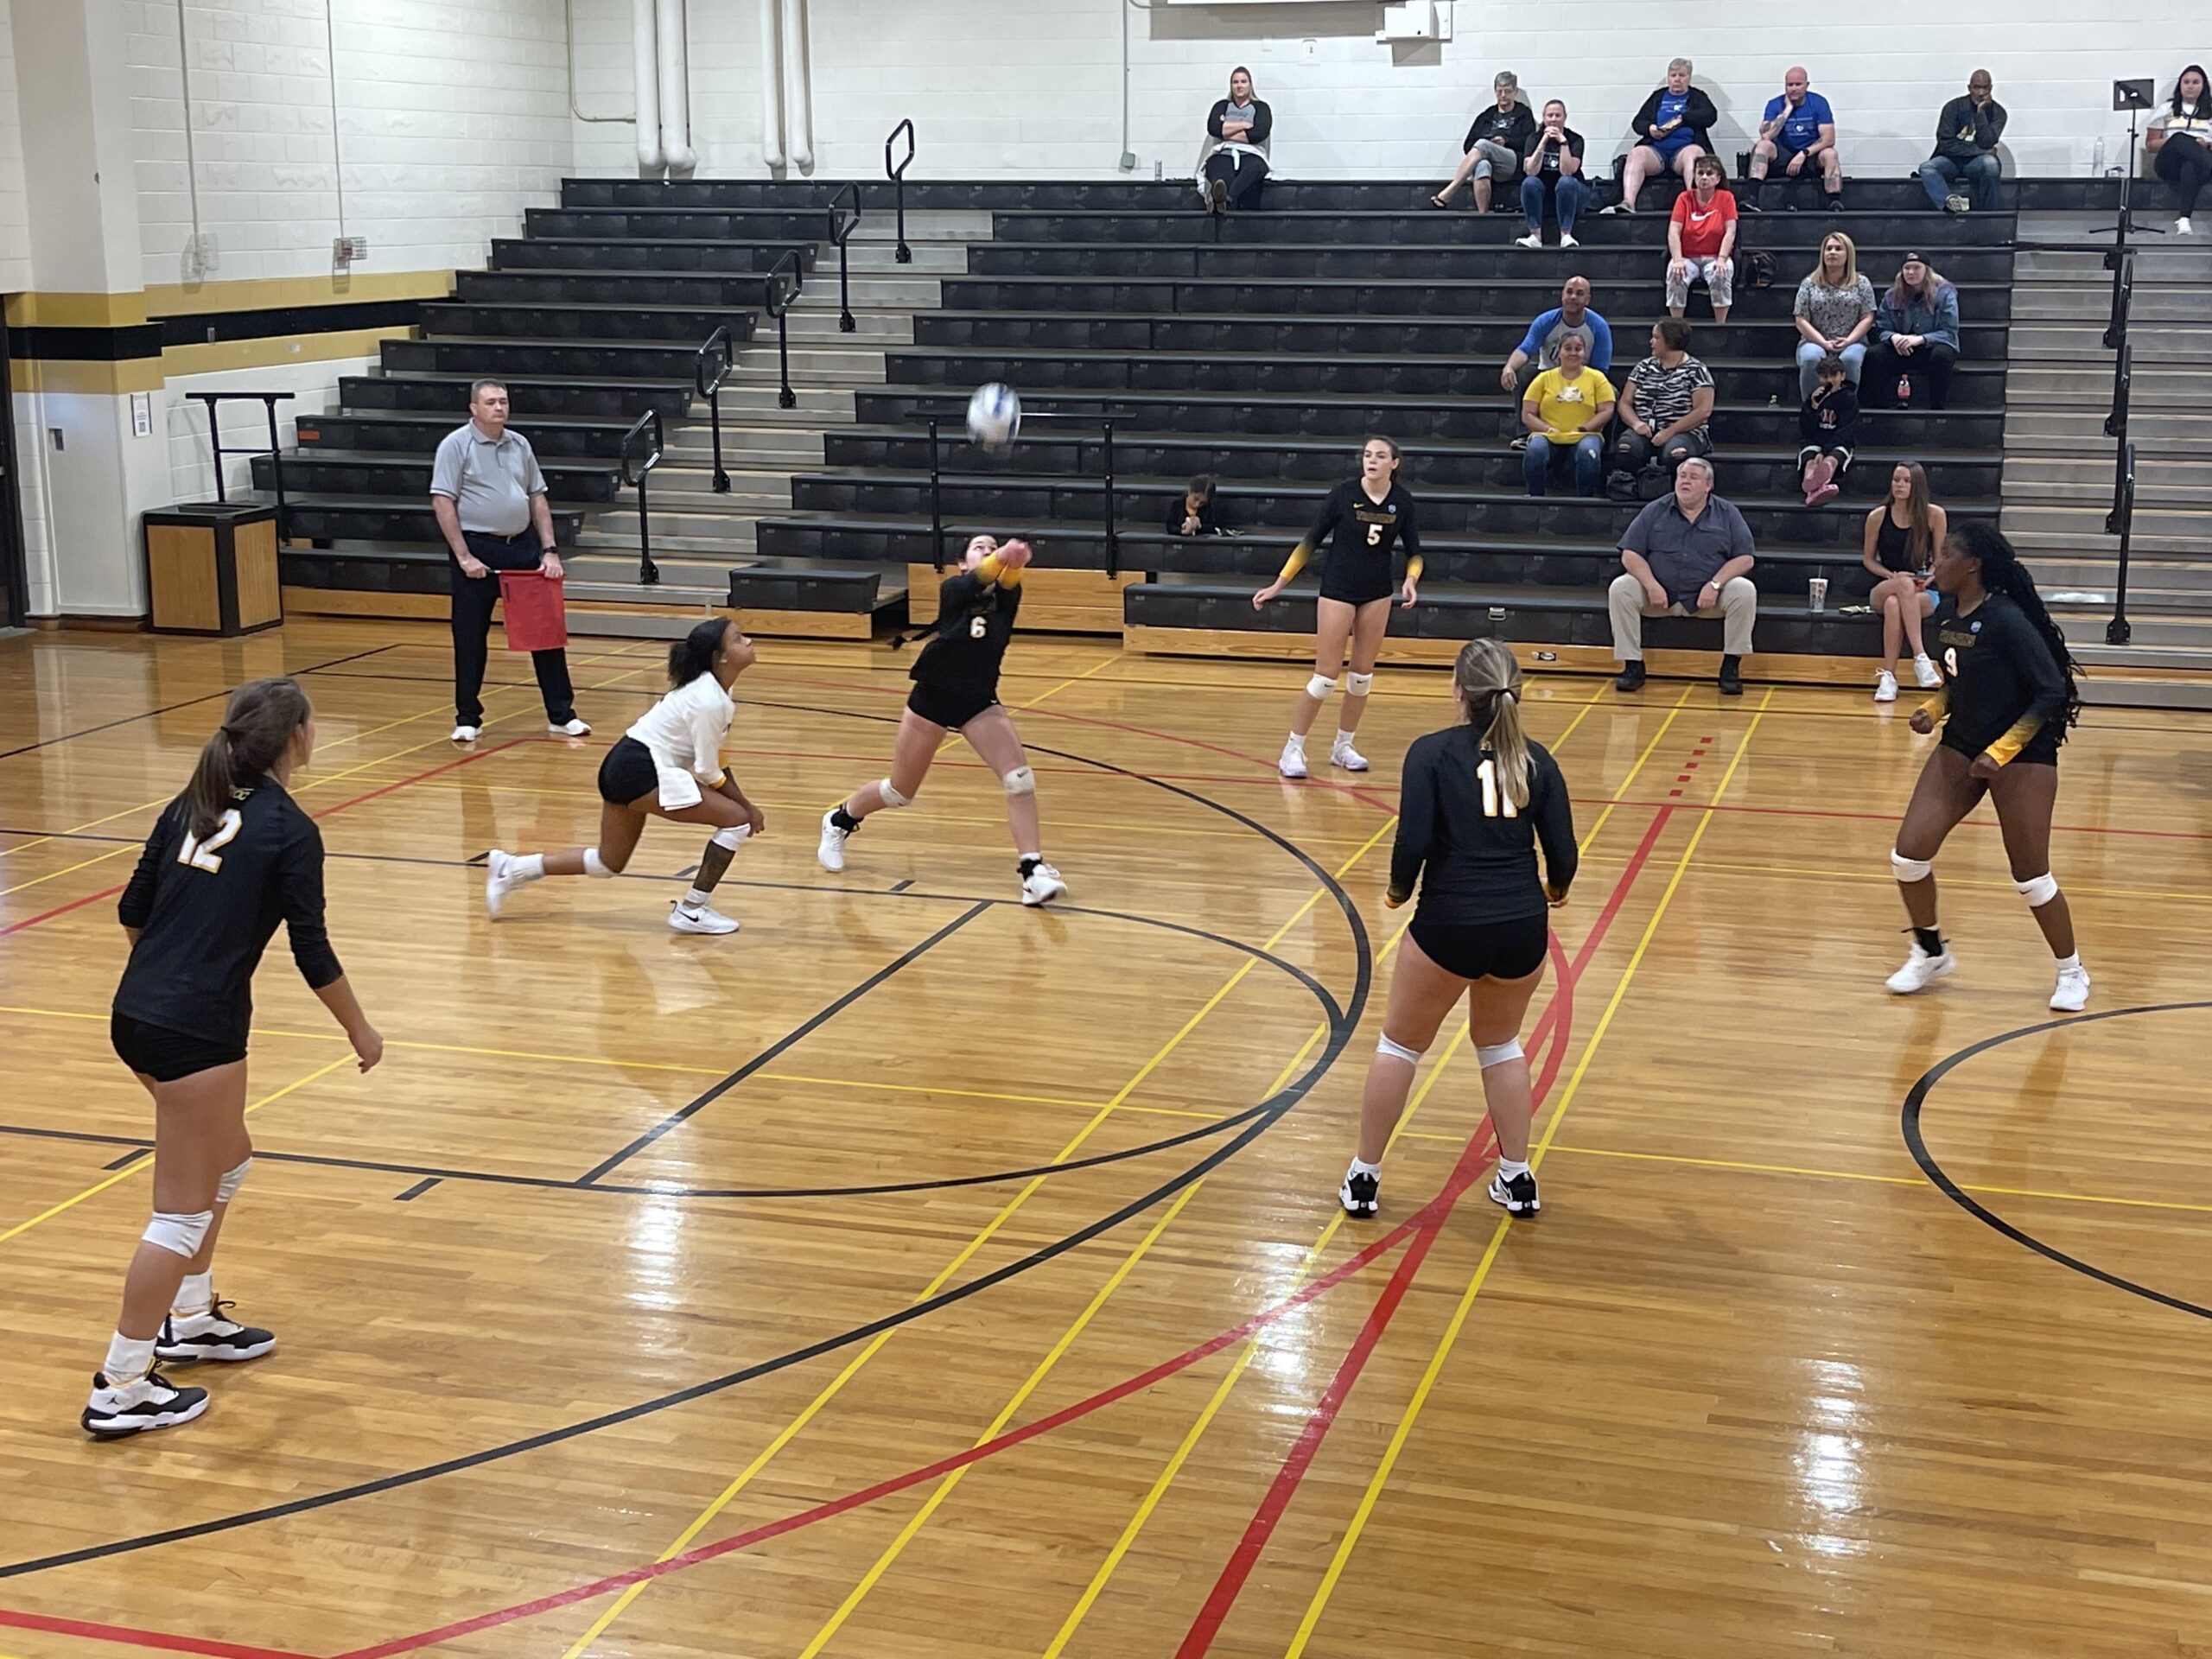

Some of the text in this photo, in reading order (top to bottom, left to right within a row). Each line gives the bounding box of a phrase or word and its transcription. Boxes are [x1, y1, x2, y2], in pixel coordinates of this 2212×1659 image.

[1367, 524, 1382, 545] 5
[969, 616, 988, 639] 6
[1944, 647, 1958, 677] 9
